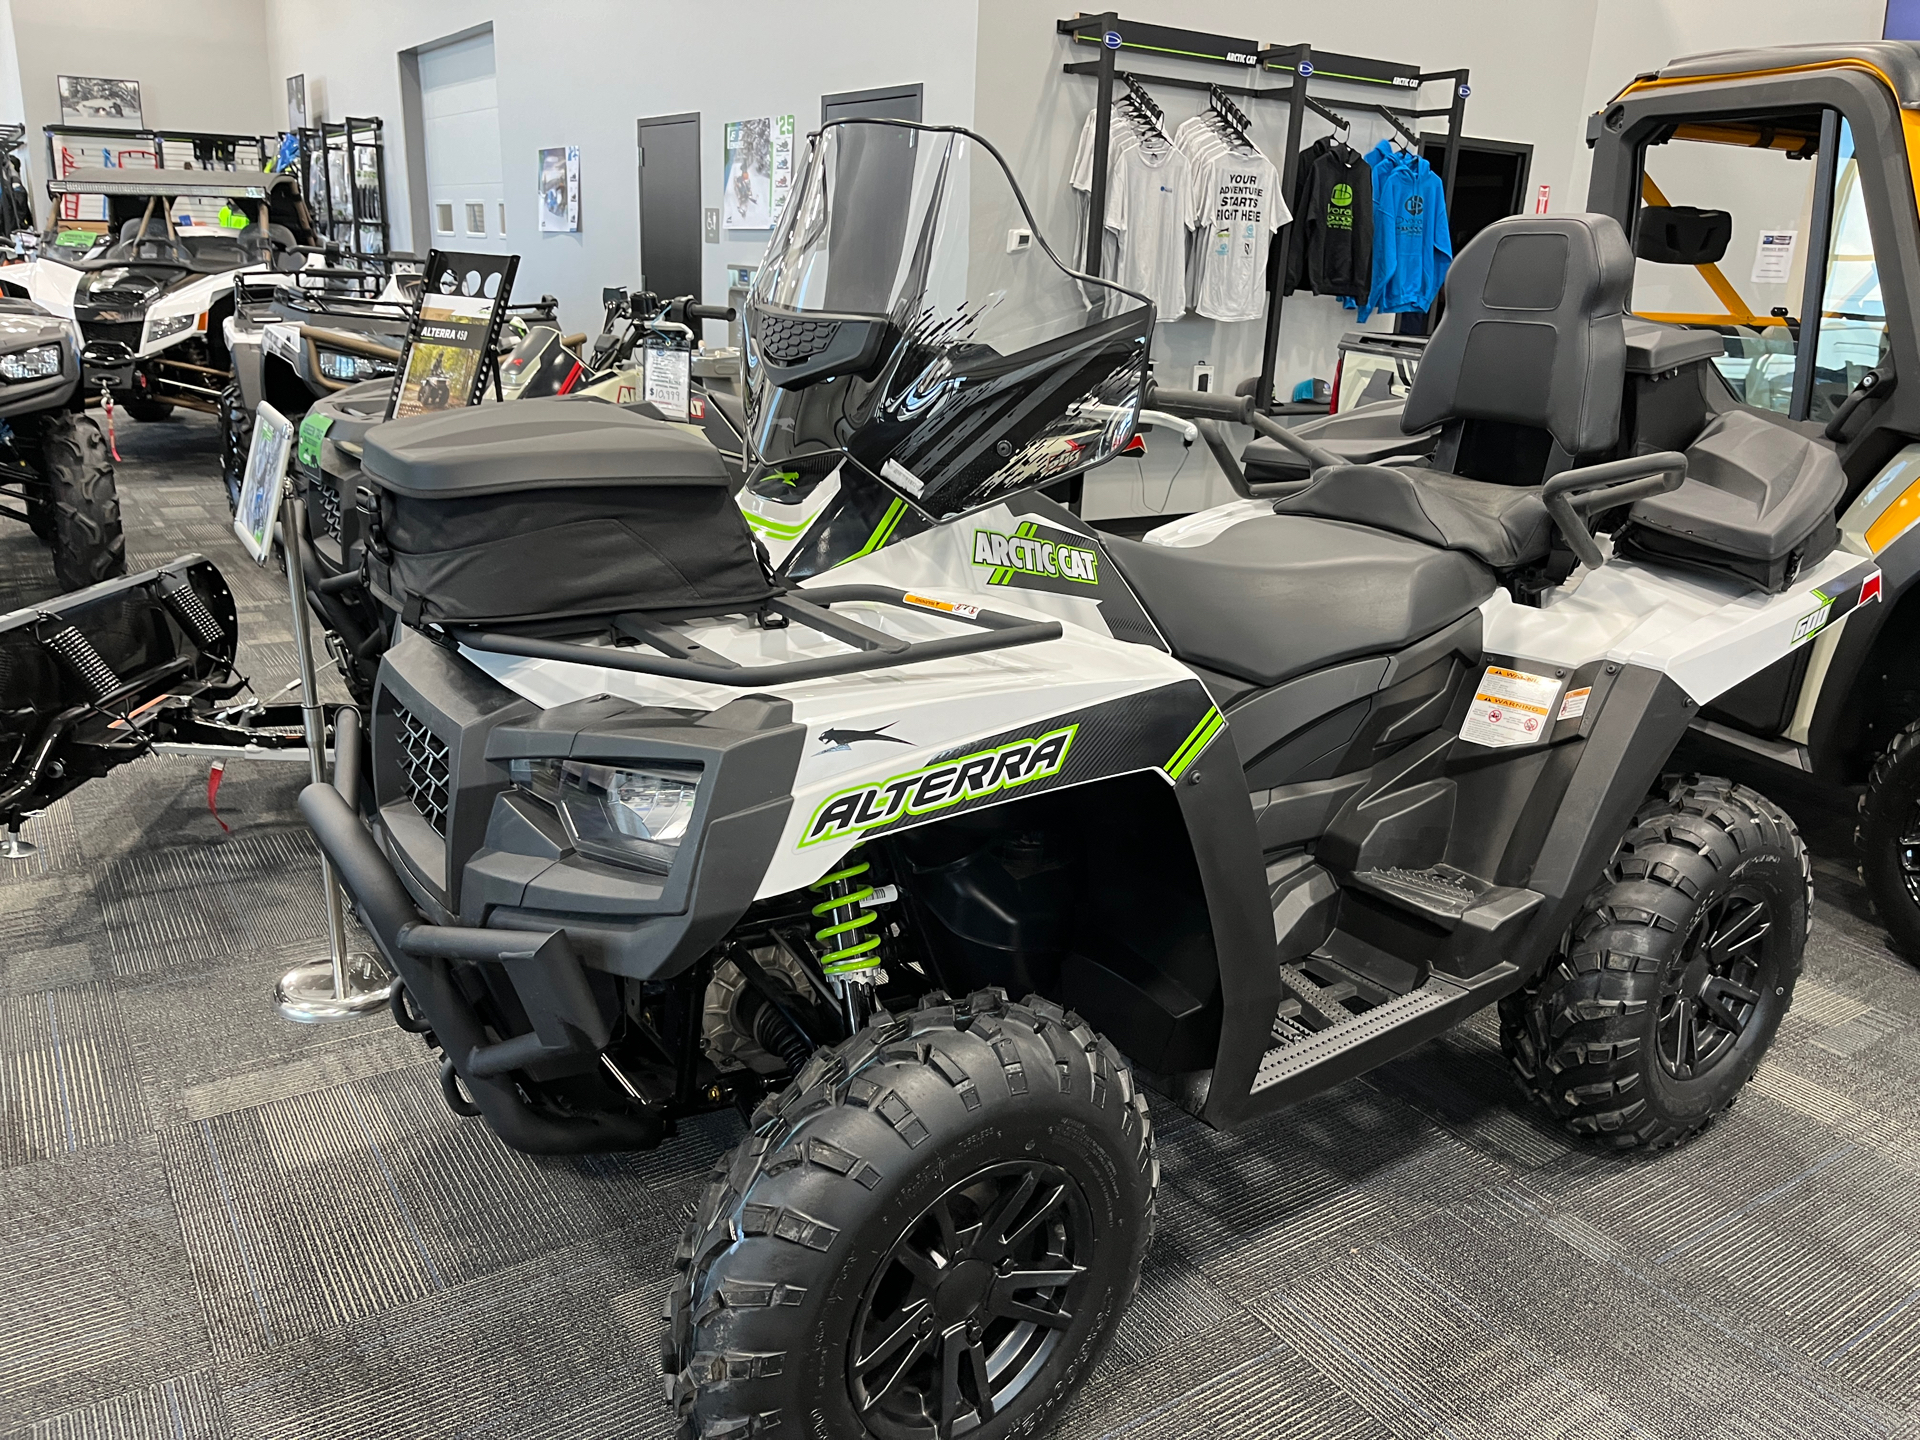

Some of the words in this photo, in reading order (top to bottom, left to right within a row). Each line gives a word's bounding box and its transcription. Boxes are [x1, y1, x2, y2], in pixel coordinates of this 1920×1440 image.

[1226, 52, 1246, 64] ARCTIC
[1246, 55, 1258, 65] CAT
[1392, 76, 1409, 87] ARCTIC
[1409, 79, 1419, 88] CAT
[1230, 174, 1257, 185] YOUR
[1220, 196, 1259, 208] STARTS
[420, 326, 456, 340] ALTERRA
[456, 330, 468, 341] 450
[974, 531, 1058, 575] ARCTIC
[1058, 546, 1097, 581] CAT
[1494, 698, 1539, 713] WARNING
[810, 735, 1069, 838] ALTERRA
